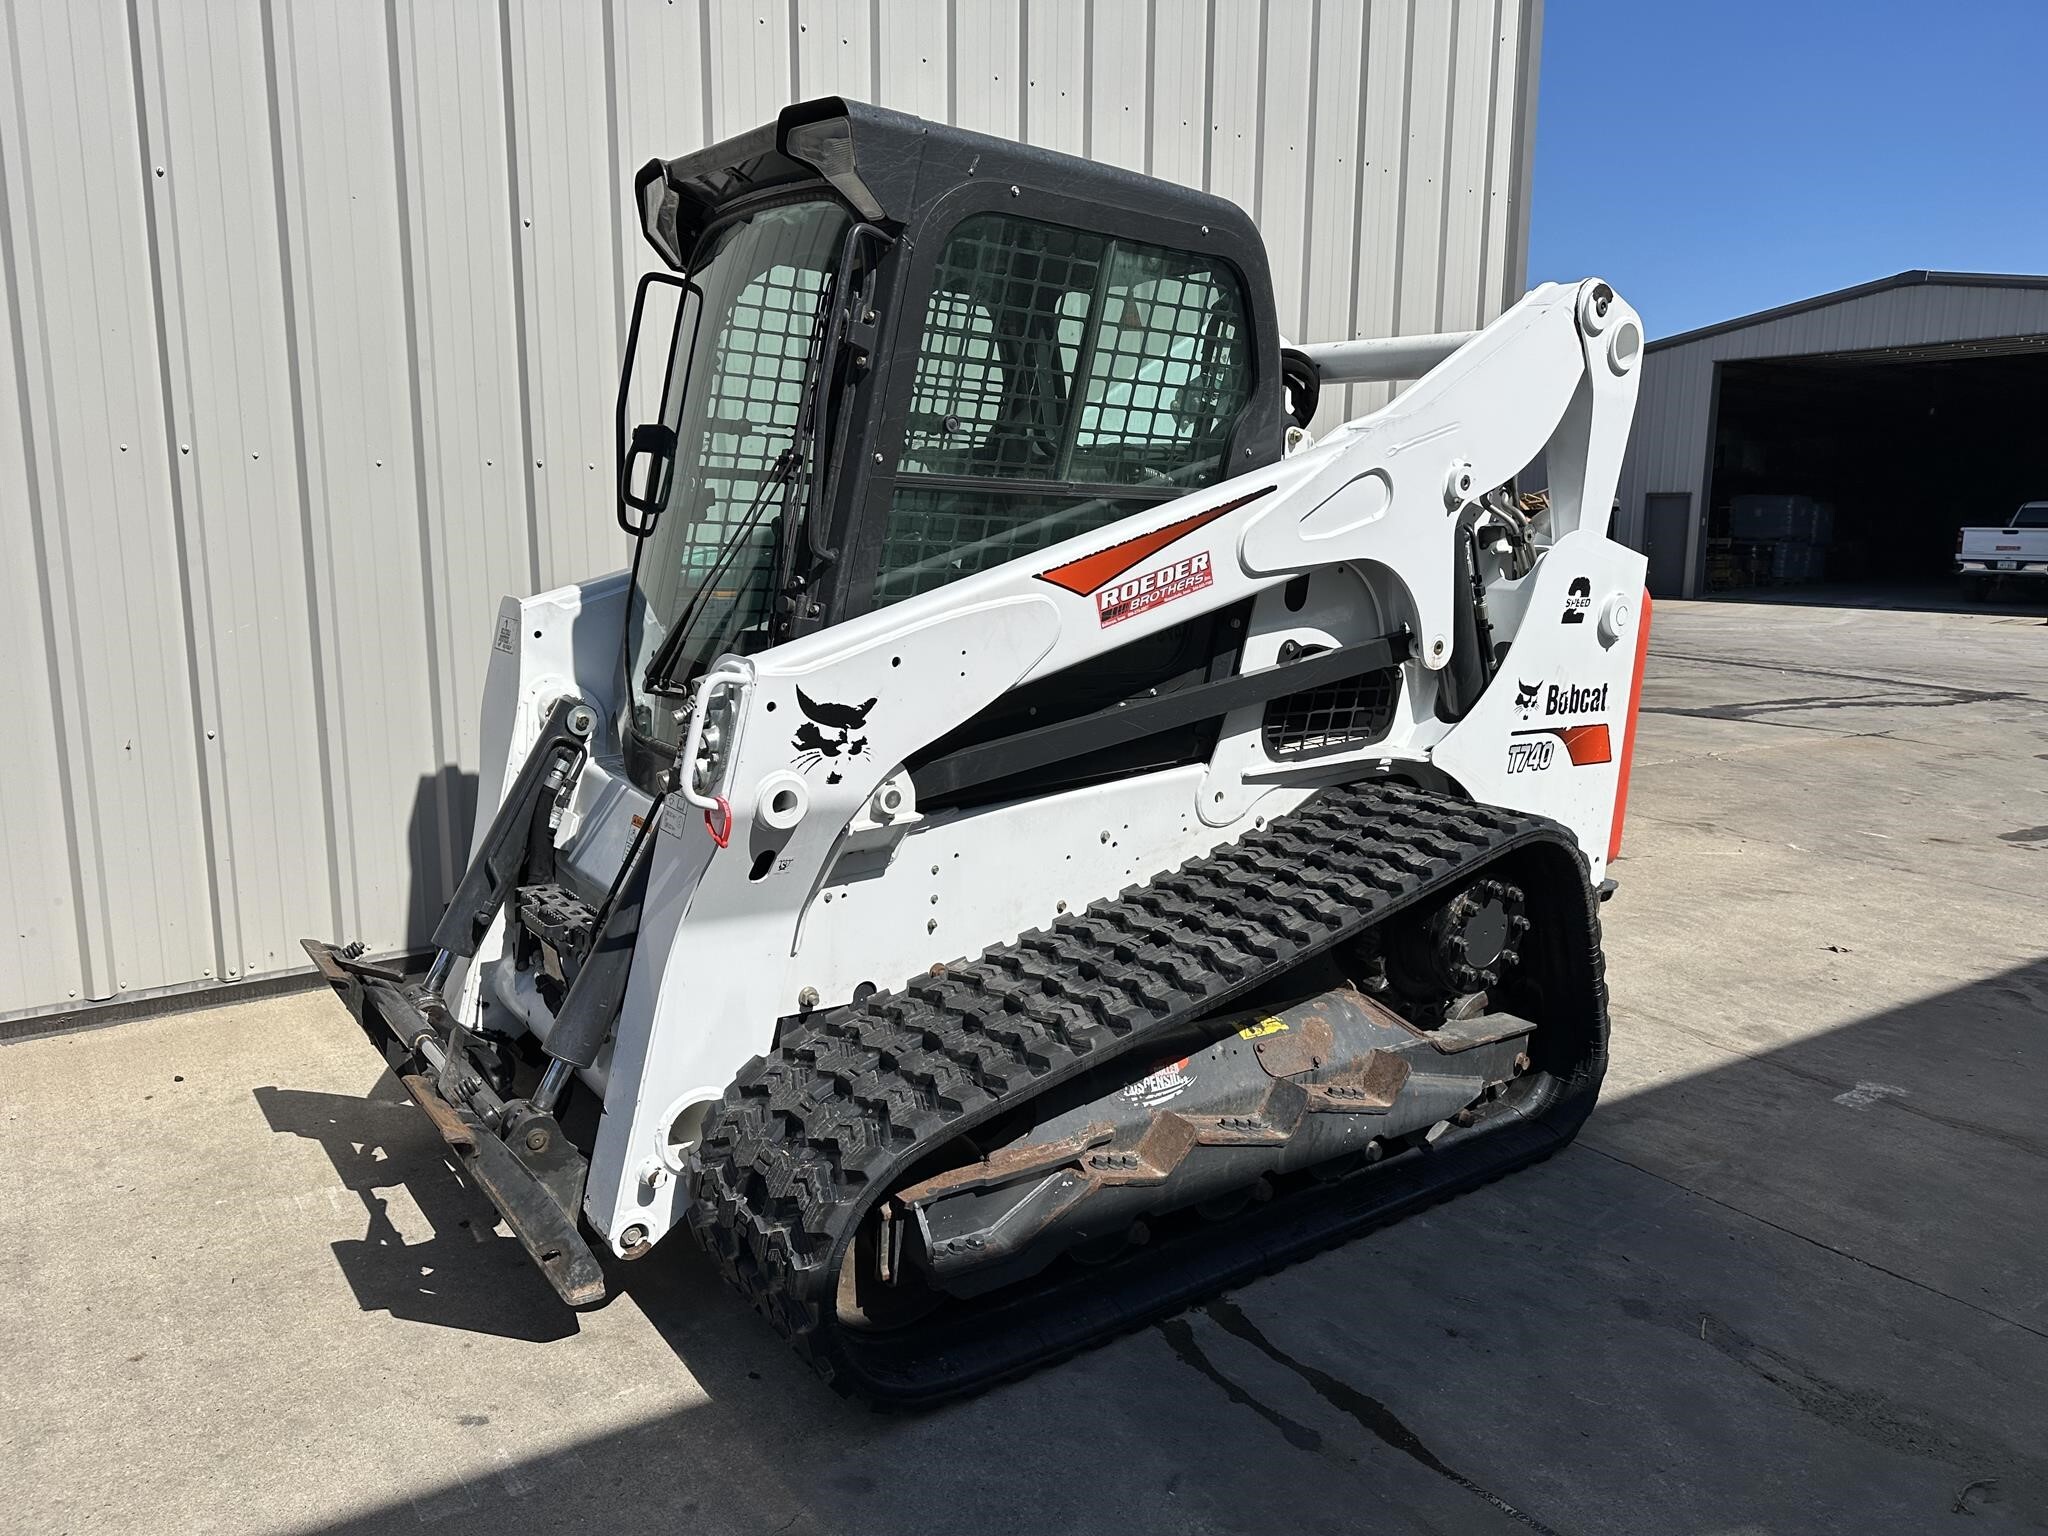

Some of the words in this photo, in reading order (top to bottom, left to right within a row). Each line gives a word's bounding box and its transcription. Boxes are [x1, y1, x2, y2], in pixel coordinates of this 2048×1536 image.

[1101, 553, 1208, 609] ROEDER
[1130, 573, 1204, 610] BROTHERS
[1561, 577, 1591, 624] 2
[1546, 683, 1608, 715] Bobcat
[1507, 741, 1555, 774] T740
